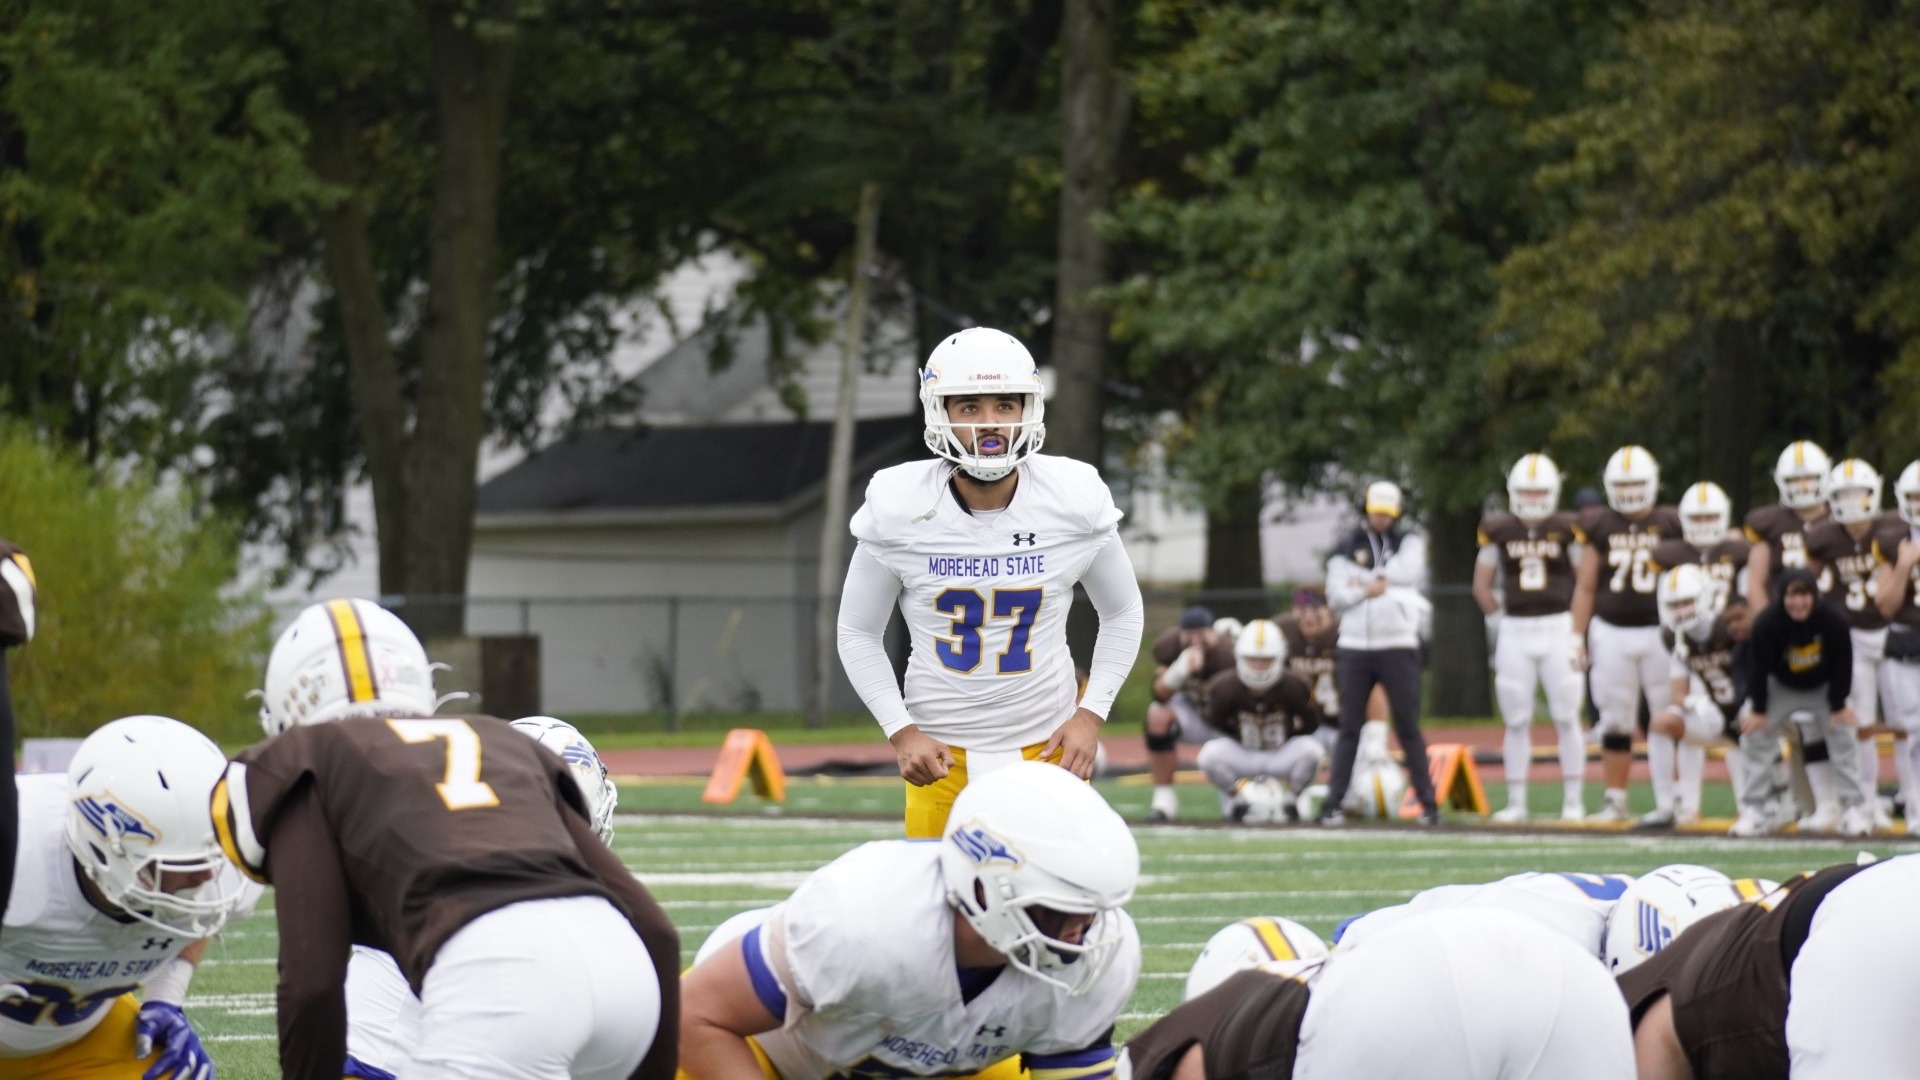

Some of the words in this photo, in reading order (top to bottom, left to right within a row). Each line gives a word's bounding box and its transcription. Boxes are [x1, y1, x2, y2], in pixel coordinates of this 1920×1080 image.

[976, 373, 1001, 381] Riddell
[928, 556, 999, 577] MOREHEAD
[1006, 555, 1045, 574] STATE
[1608, 549, 1657, 592] 70
[933, 586, 1045, 675] 37
[386, 718, 500, 810] 7
[25, 958, 119, 980] MOREHEAD
